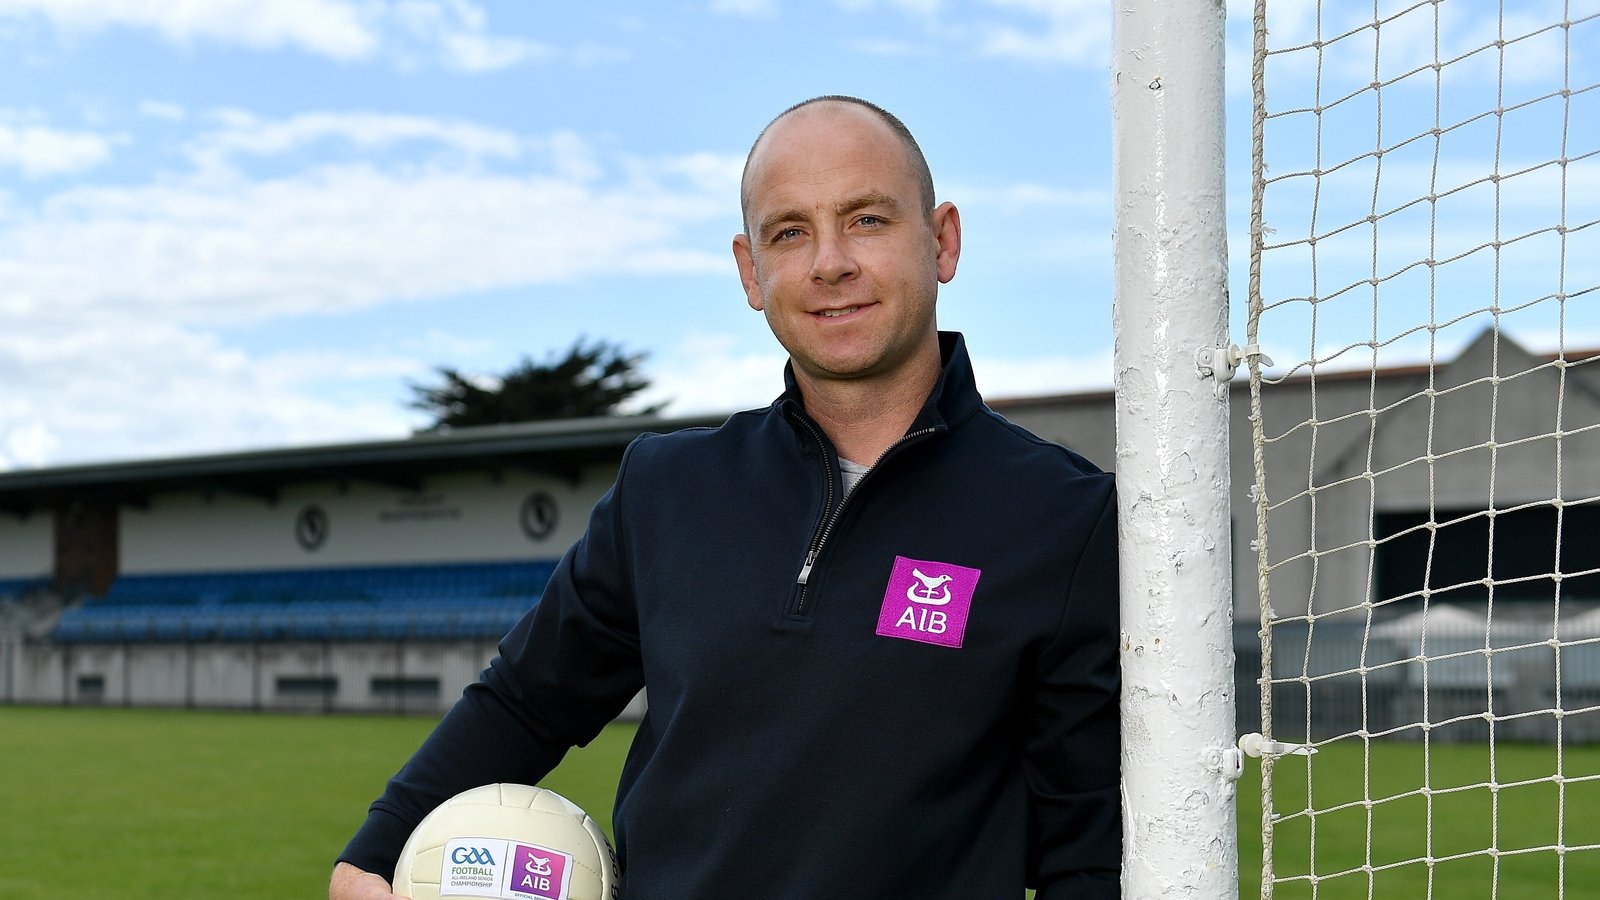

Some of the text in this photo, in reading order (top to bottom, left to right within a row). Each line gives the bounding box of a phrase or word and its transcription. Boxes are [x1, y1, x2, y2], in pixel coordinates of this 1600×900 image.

[895, 606, 947, 634] AIB
[451, 846, 496, 866] GAA
[451, 866, 494, 876] FOOTBALL
[450, 880, 493, 888] CHAMPIONSHIP
[520, 874, 551, 891] AIB
